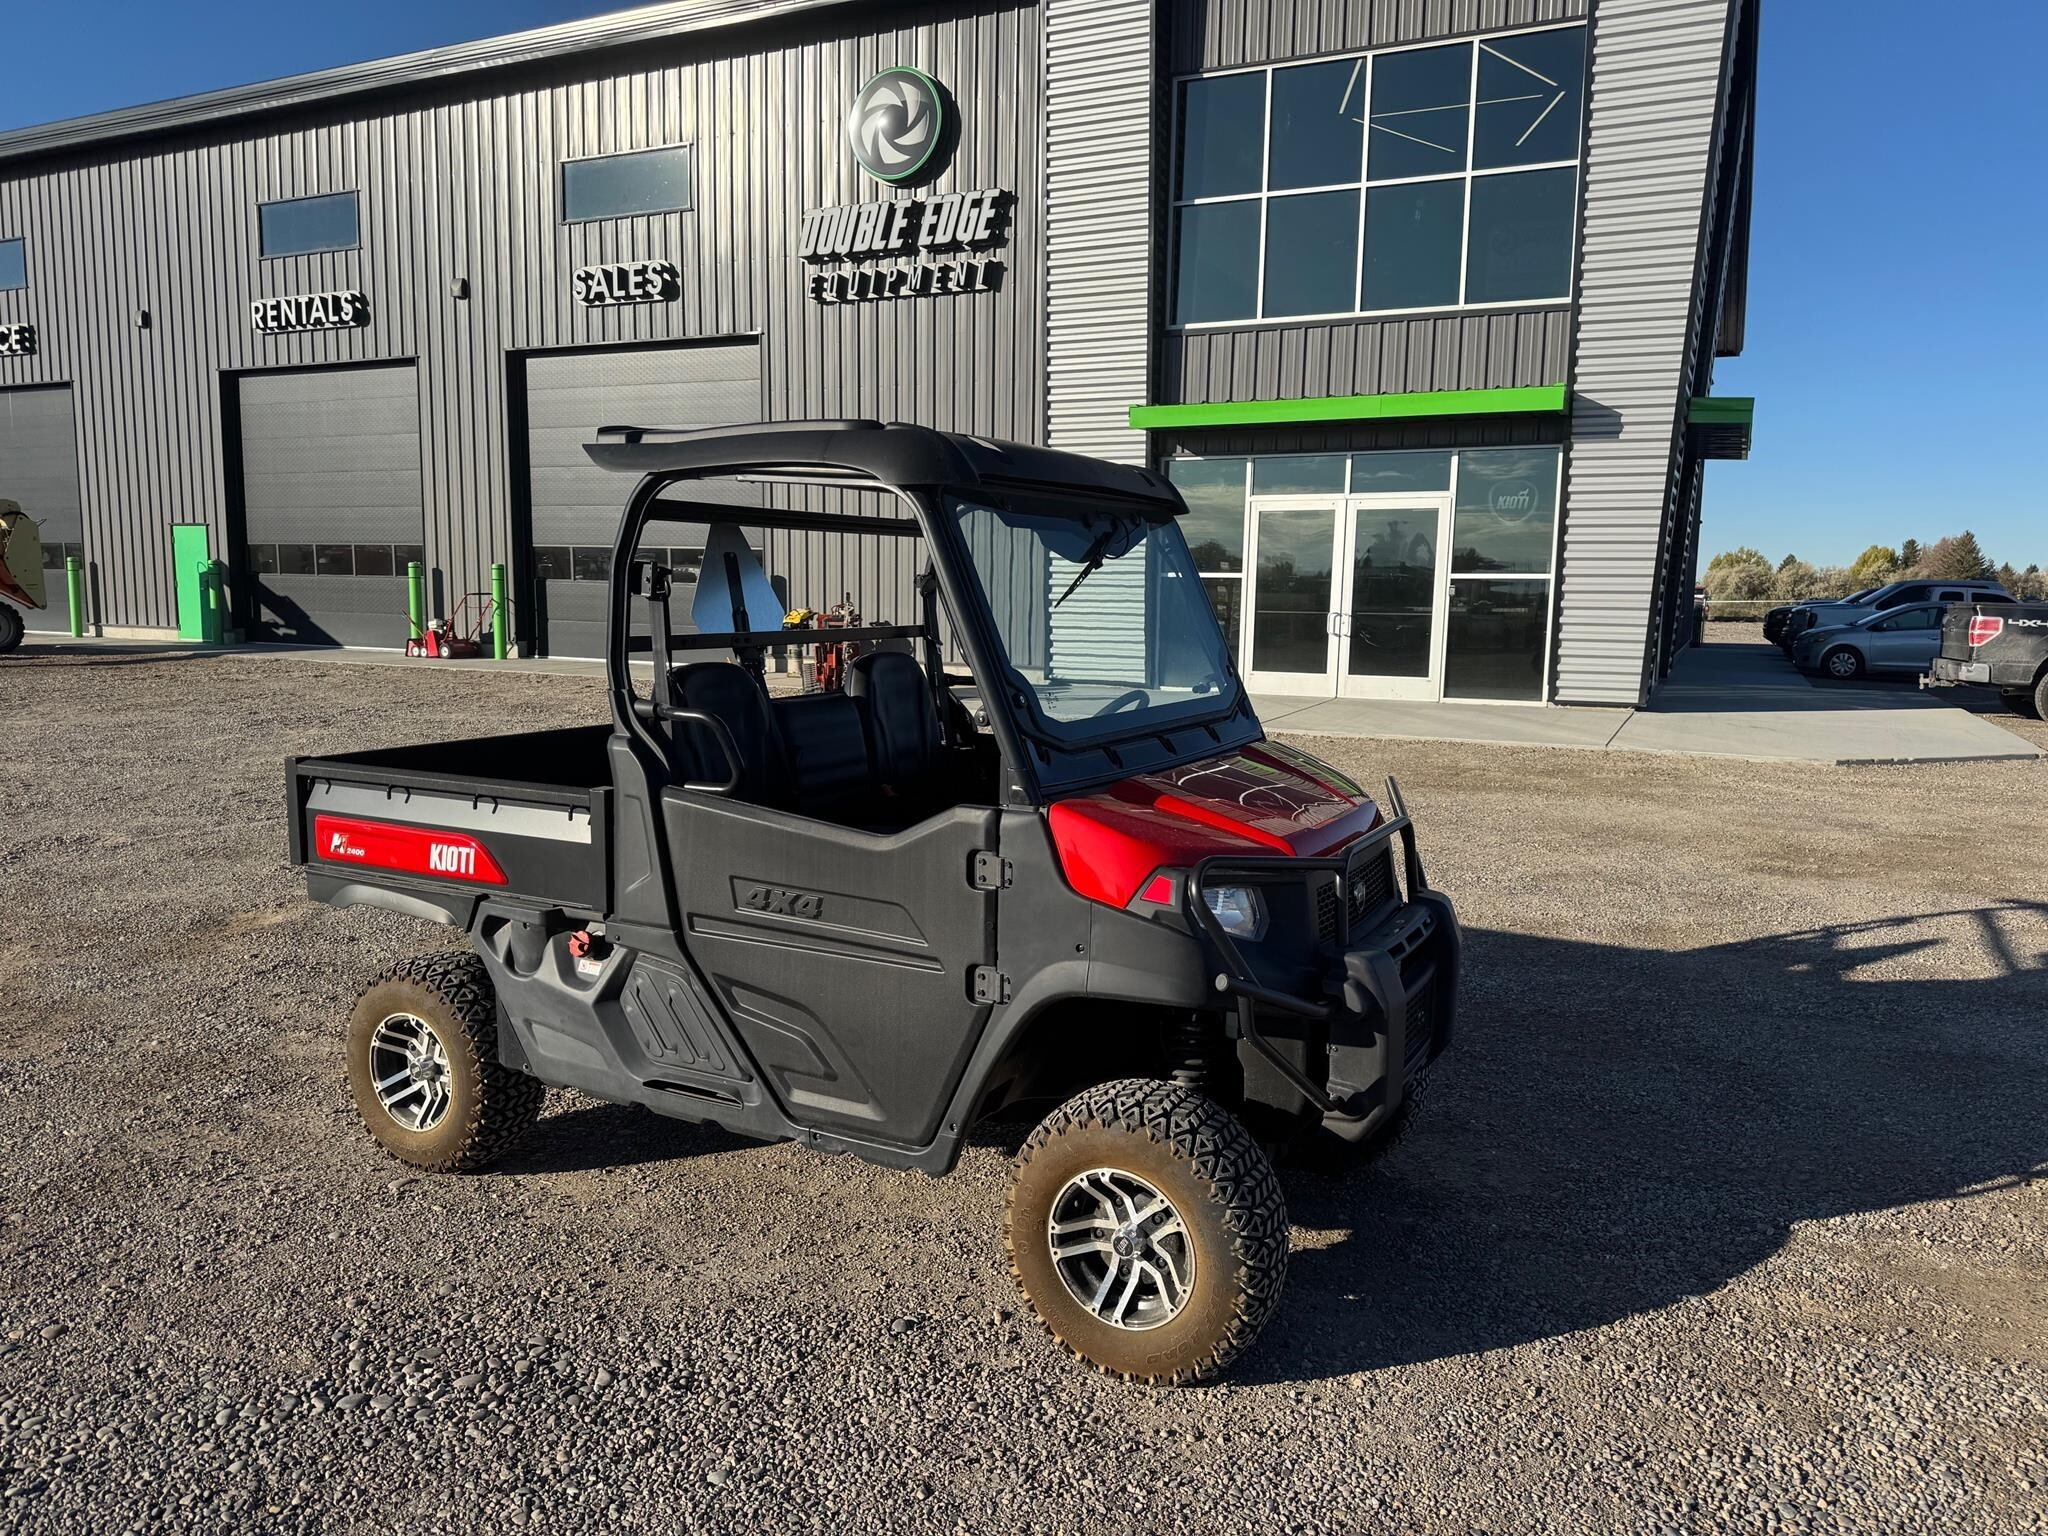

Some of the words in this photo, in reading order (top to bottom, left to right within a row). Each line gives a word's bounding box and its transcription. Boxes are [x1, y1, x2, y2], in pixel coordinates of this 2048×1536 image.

[798, 199, 912, 257] DOUBLE
[918, 189, 1000, 247] EDGE
[572, 261, 663, 300] SALES
[808, 259, 988, 299] EQUIPMENT
[251, 292, 353, 329] RENTALS
[1496, 494, 1530, 510] KIOTI
[346, 847, 366, 857] 2400
[429, 843, 476, 875] KIOTI
[745, 885, 825, 920] 4X4
